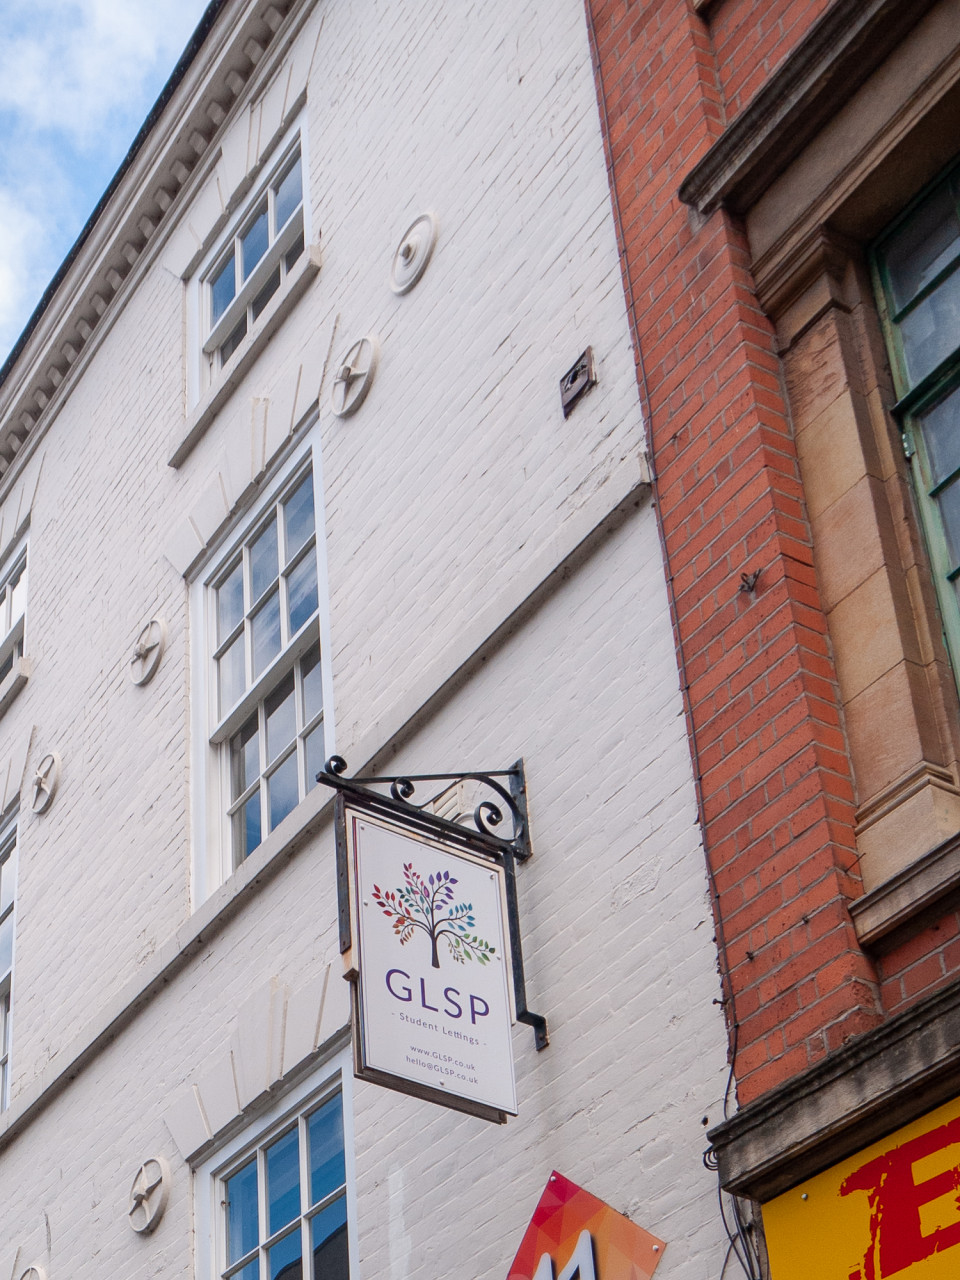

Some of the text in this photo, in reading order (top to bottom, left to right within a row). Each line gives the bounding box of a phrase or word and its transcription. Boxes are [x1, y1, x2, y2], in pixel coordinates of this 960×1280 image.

[385, 968, 490, 1025] GLSP
[399, 1012, 480, 1046] Student Lettings
[406, 1055, 479, 1085] hello@GLSP.co.uk
[410, 1045, 476, 1071] www.GLSP.co.uk
